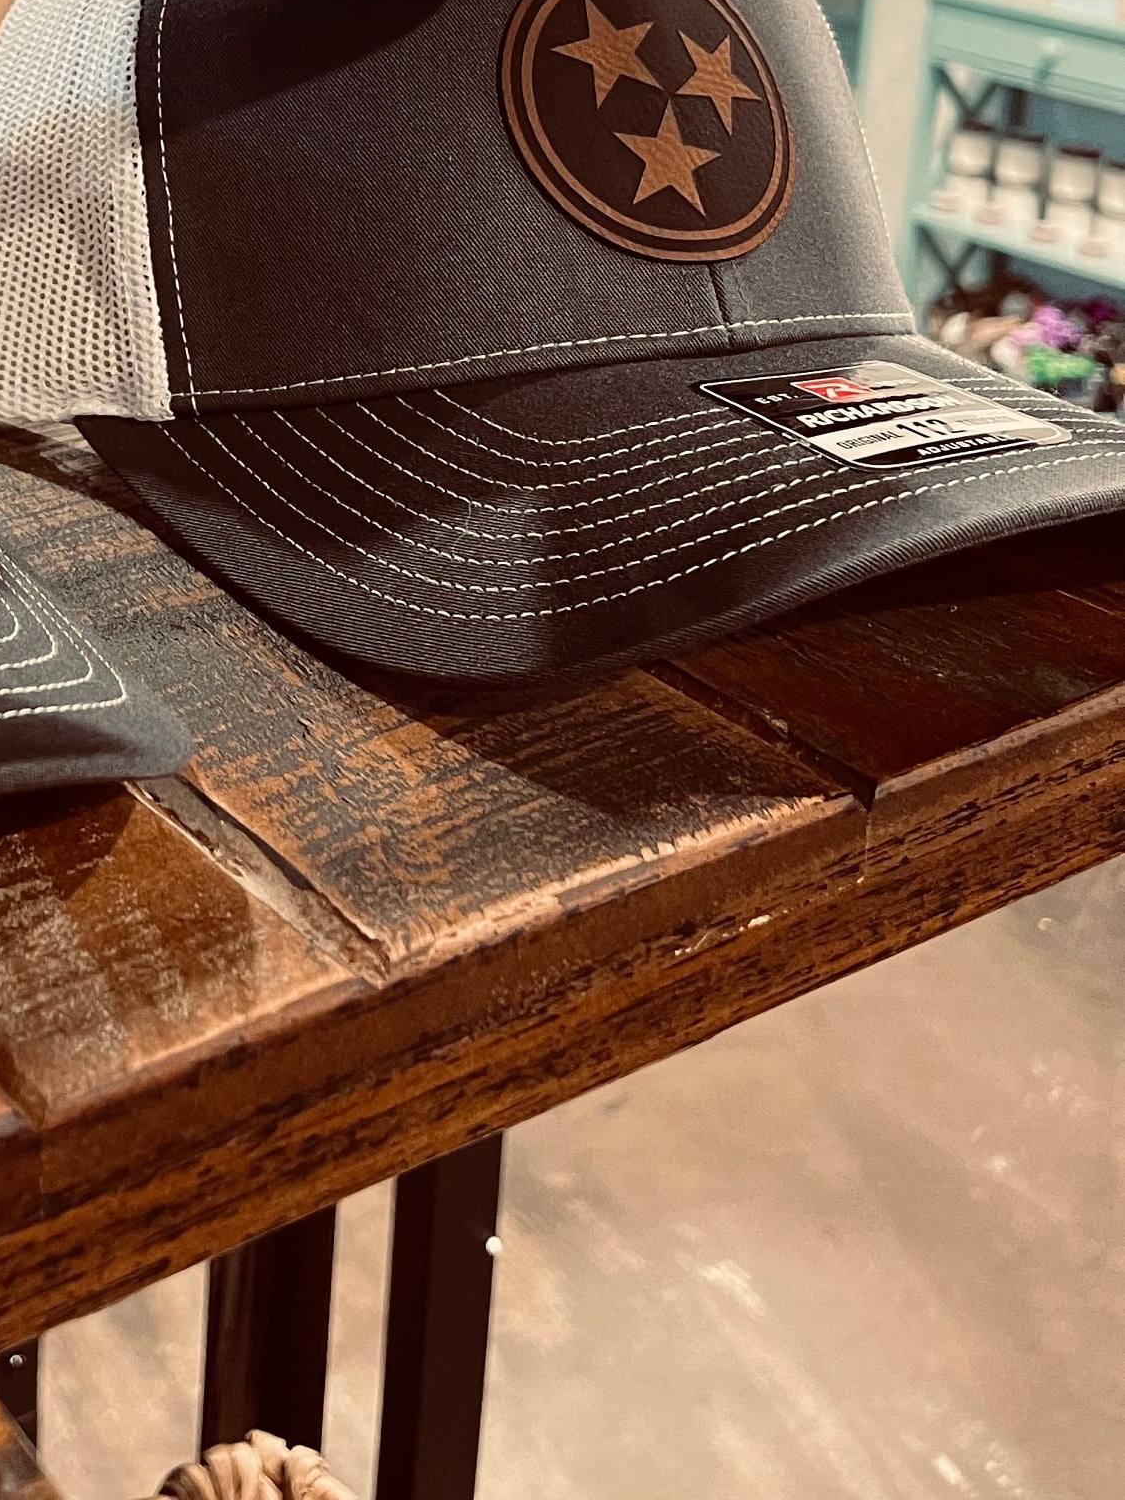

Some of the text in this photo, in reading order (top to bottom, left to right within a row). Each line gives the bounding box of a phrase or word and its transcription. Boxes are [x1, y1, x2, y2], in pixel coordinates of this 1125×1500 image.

[796, 395, 965, 428] RICHARDSON
[836, 430, 904, 450] ORIGINAL
[896, 418, 968, 439] 112
